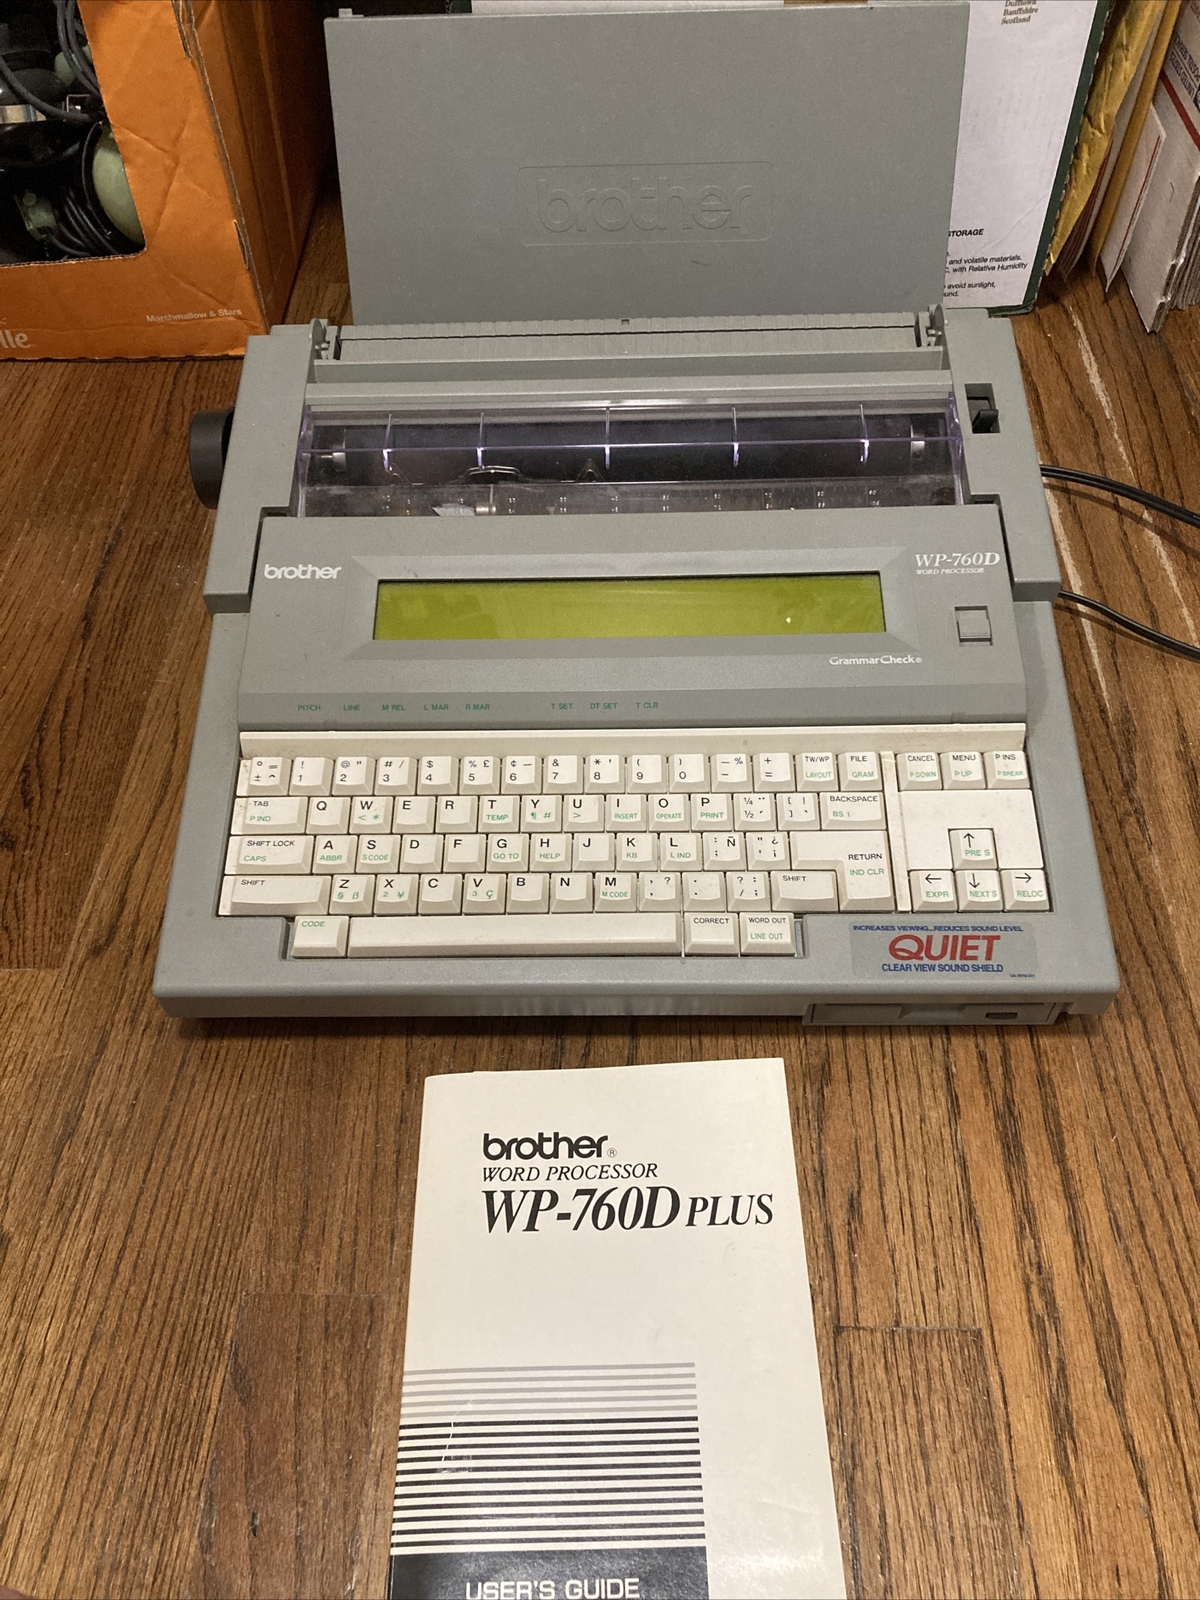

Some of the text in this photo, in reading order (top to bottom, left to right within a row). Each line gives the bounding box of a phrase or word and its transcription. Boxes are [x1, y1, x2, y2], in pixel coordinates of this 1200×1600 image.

[1001, 15, 1031, 25] Scotland
[537, 177, 753, 233] brother
[997, 262, 1028, 270] Humidity
[146, 312, 206, 323] Marshmallow
[218, 308, 242, 316] Stars
[915, 552, 1000, 567] WP-760D
[264, 564, 342, 579] brother
[340, 760, 350, 768] @
[426, 760, 433, 768] $
[468, 760, 477, 768] %
[552, 759, 559, 767] &
[340, 774, 347, 782] 2
[382, 774, 390, 782] 3
[468, 773, 475, 781] 5
[509, 773, 517, 781] 6
[552, 772, 559, 780] 7
[594, 772, 601, 780] 8
[636, 772, 643, 780] 9
[316, 801, 328, 811] Q
[360, 801, 373, 810] W
[402, 801, 412, 810] E
[445, 800, 454, 809] R
[488, 800, 497, 809] T
[530, 800, 540, 808] Y
[573, 799, 582, 808] U
[658, 798, 669, 808] O
[701, 798, 710, 807] P
[323, 840, 333, 849] A
[367, 840, 376, 849] S
[410, 840, 420, 849] D
[453, 839, 462, 848] F
[497, 838, 507, 848] G
[540, 838, 550, 847] H
[583, 838, 591, 847] J
[627, 837, 636, 847] K
[670, 837, 678, 847] L
[727, 836, 736, 847] Ñ
[339, 879, 349, 888] Z
[383, 879, 394, 888] X
[428, 878, 438, 888] C
[473, 878, 483, 887] V
[517, 877, 526, 886] B
[560, 877, 570, 886] N
[605, 877, 616, 886] M
[486, 890, 494, 899] Ç
[889, 934, 1001, 961] QUIET
[882, 964, 912, 972] CLEAR
[914, 964, 936, 972] VIEW
[483, 1163, 658, 1182] WORD PROCESSOR
[482, 1185, 774, 1234] WP-760D PLUS
[466, 1578, 640, 1600] USER'S GUIDE
